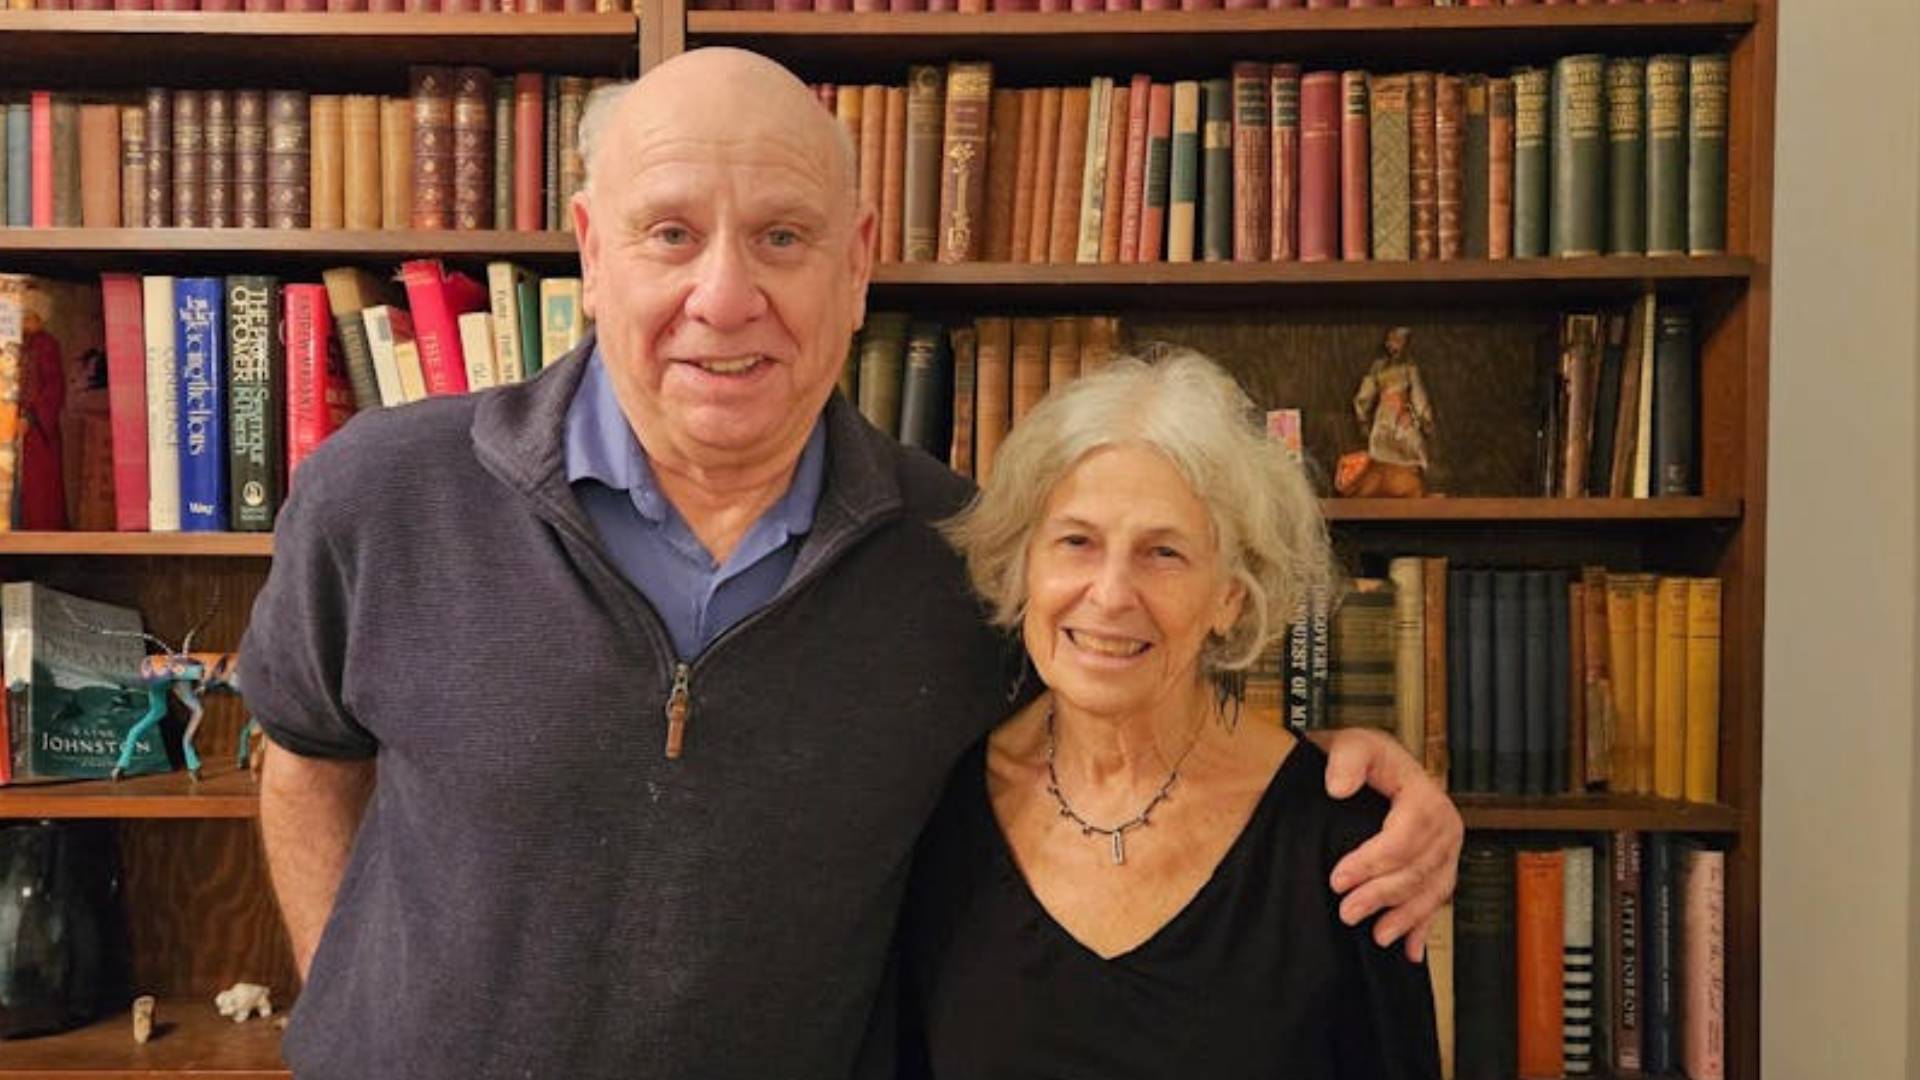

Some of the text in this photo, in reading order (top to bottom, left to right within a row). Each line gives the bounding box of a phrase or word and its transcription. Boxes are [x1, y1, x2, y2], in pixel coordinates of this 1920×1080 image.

[231, 286, 252, 382] OF POWER
[249, 287, 269, 382] THE PRICE
[249, 387, 269, 465] Seymour
[1291, 677, 1307, 699] OF
[1621, 894, 1636, 1027] AFTER SORROW
